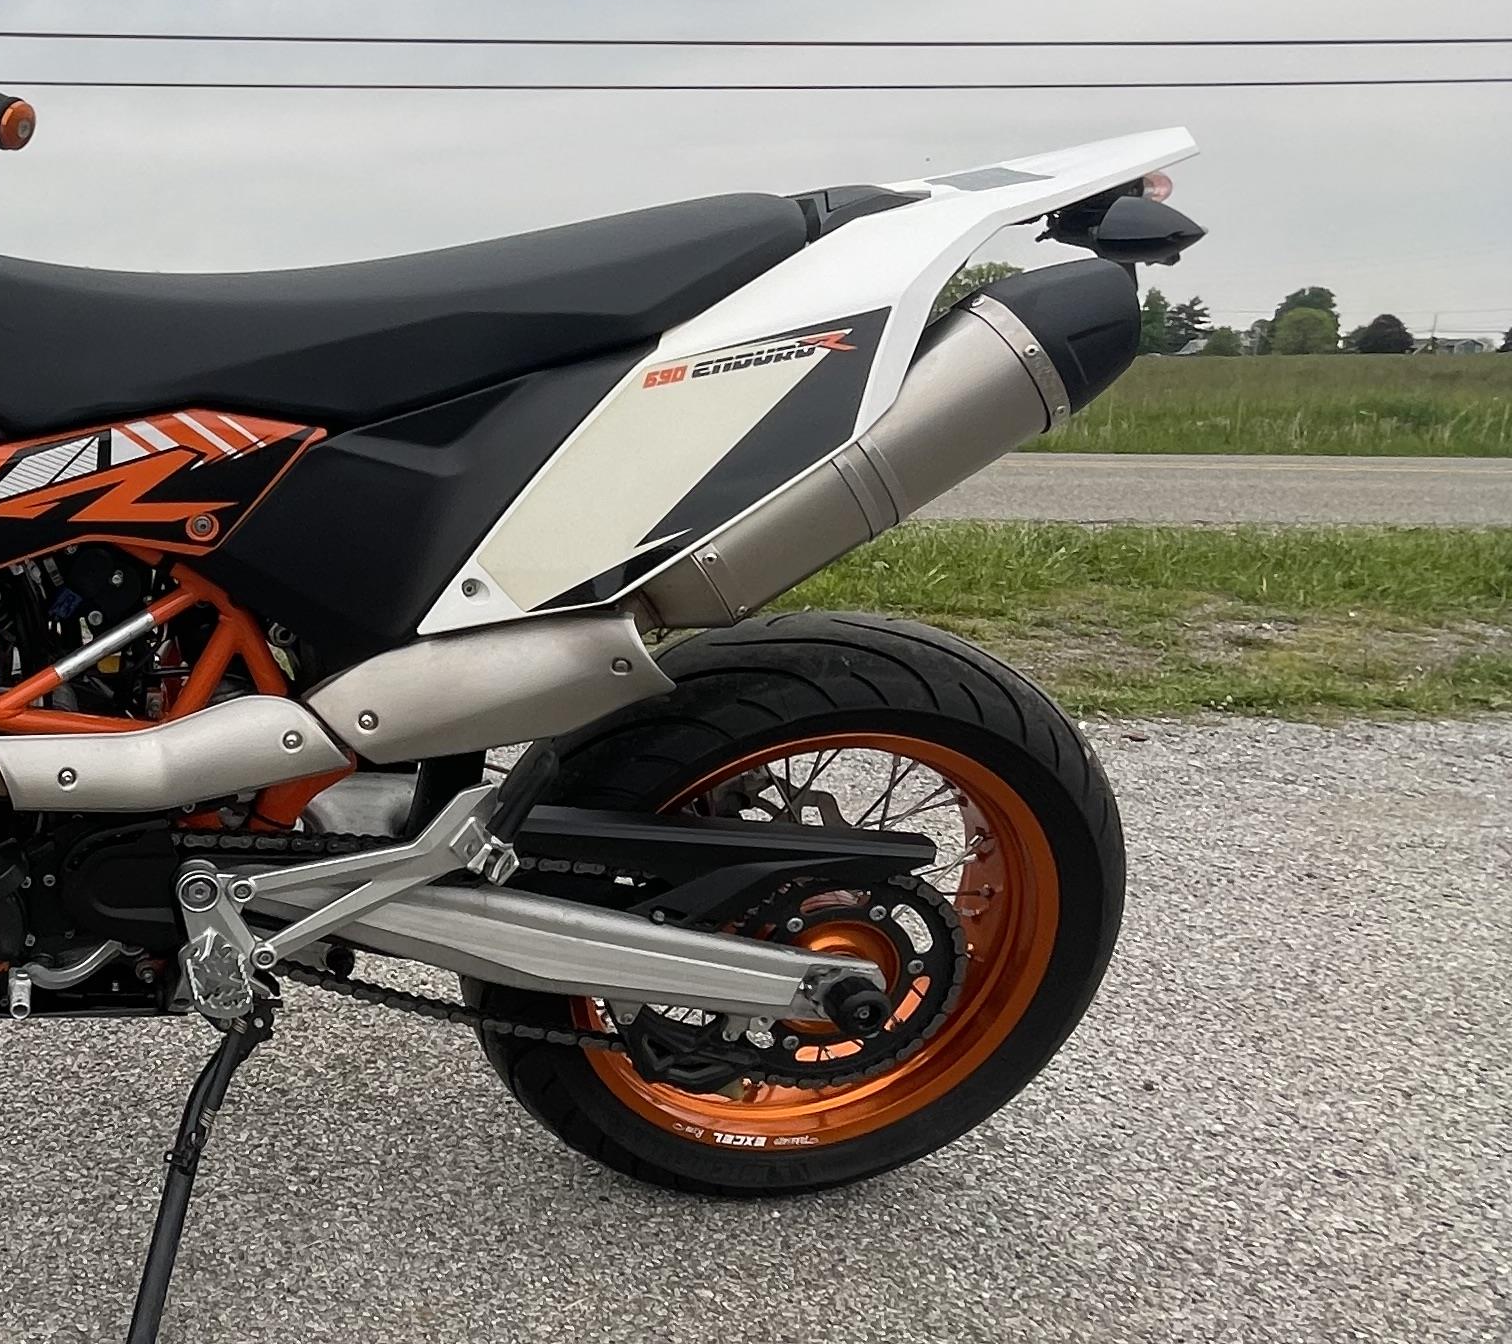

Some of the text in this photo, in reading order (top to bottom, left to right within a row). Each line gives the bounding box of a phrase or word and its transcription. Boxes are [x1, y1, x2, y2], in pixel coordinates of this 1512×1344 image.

[643, 365, 687, 389] 690
[692, 342, 818, 378] ENDURO
[713, 1132, 767, 1147] EXCEL
